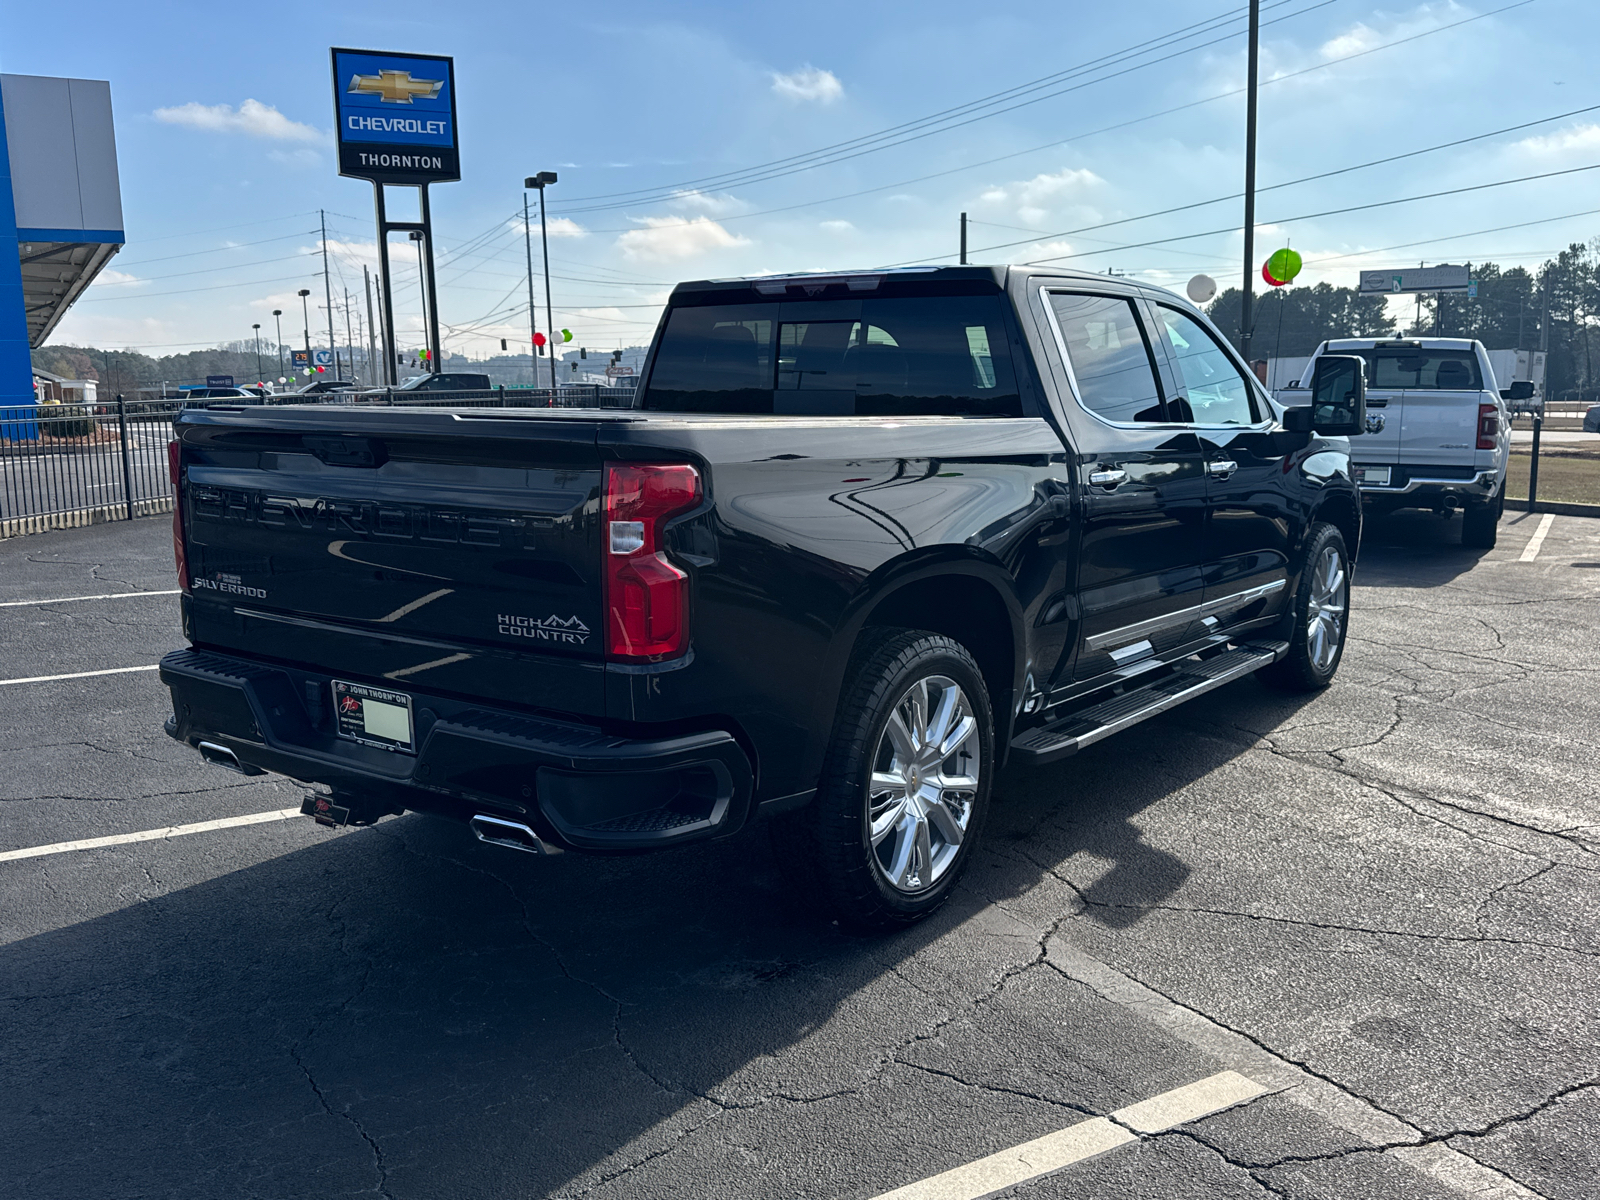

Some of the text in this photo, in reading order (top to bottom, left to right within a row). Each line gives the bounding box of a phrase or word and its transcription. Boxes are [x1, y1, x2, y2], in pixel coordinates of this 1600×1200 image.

[348, 116, 447, 135] CHEVROLET
[359, 153, 442, 169] THORNTON
[195, 489, 554, 550] CHEVROLET
[191, 577, 267, 599] SILVERADO
[497, 613, 541, 628] HIGH
[498, 624, 590, 645] COUNTRY
[350, 686, 368, 696] JOHN
